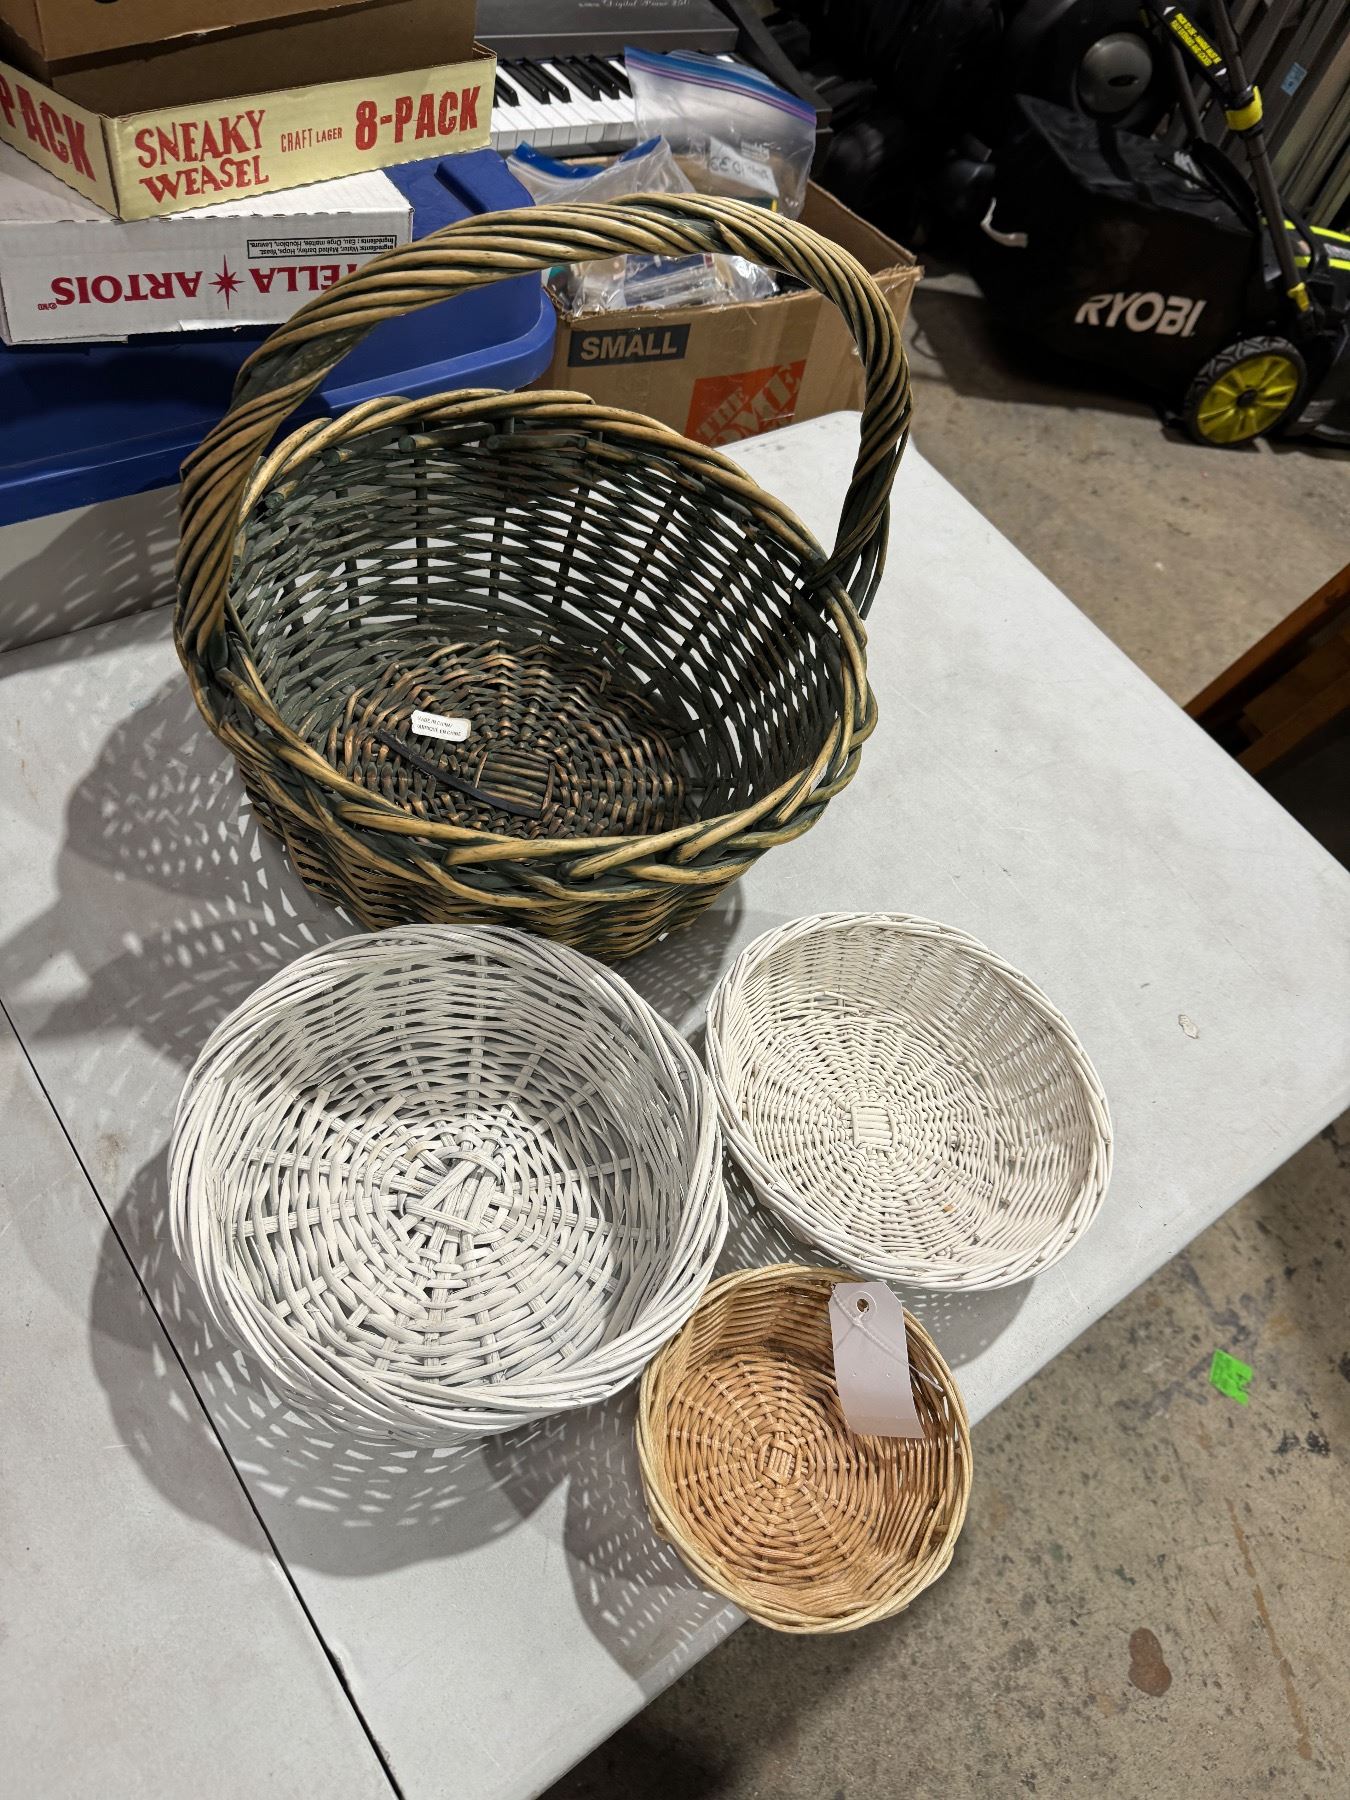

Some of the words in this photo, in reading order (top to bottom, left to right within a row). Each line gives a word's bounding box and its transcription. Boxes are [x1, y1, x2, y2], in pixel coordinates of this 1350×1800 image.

[0, 73, 97, 182] PACK
[134, 109, 266, 169] SNEAKY
[280, 128, 313, 153] CRAFT
[316, 127, 343, 144] LAGER
[354, 85, 481, 151] 8-PACK
[139, 155, 269, 204] WEASEL
[51, 271, 203, 306] ARTOIS
[248, 263, 358, 294] ELLA
[1074, 291, 1207, 338] RYOBI
[580, 331, 677, 360] SMALL
[696, 384, 749, 441] THE
[713, 363, 802, 447] OME
